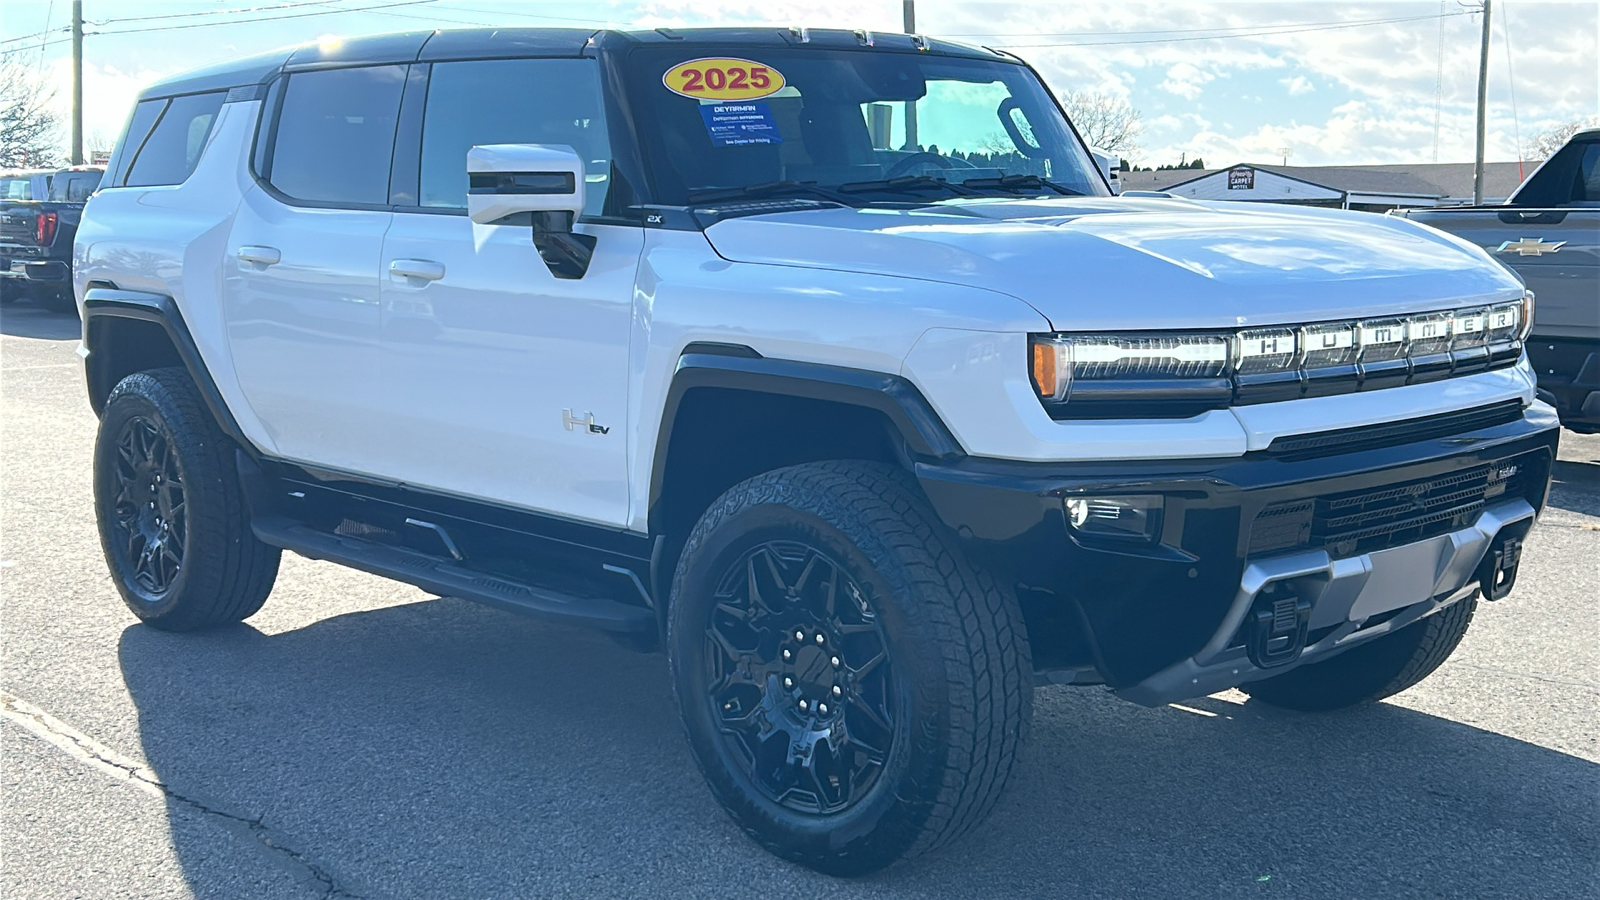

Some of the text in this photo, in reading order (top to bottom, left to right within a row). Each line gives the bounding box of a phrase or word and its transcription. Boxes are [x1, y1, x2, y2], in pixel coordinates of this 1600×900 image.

[681, 68, 771, 91] 2025
[647, 215, 662, 223] 2X
[1261, 312, 1507, 353] HUMMER
